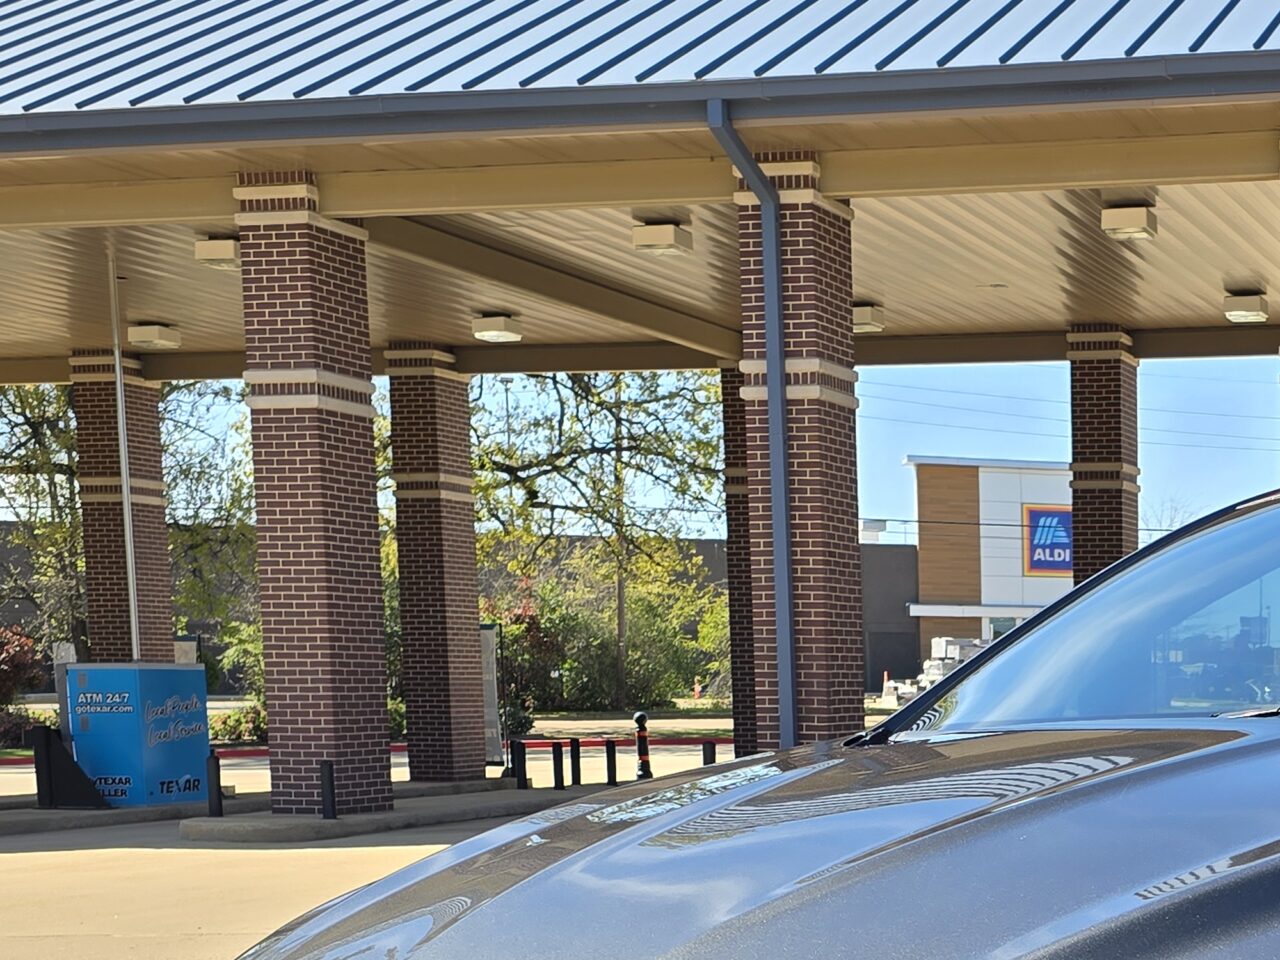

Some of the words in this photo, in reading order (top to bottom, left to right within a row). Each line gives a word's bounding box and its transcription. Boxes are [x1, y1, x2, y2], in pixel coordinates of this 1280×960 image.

[1033, 548, 1071, 562] ALDI
[78, 693, 102, 703] ATM
[75, 704, 133, 714] gotexar.com
[160, 776, 200, 796] TEXAR
